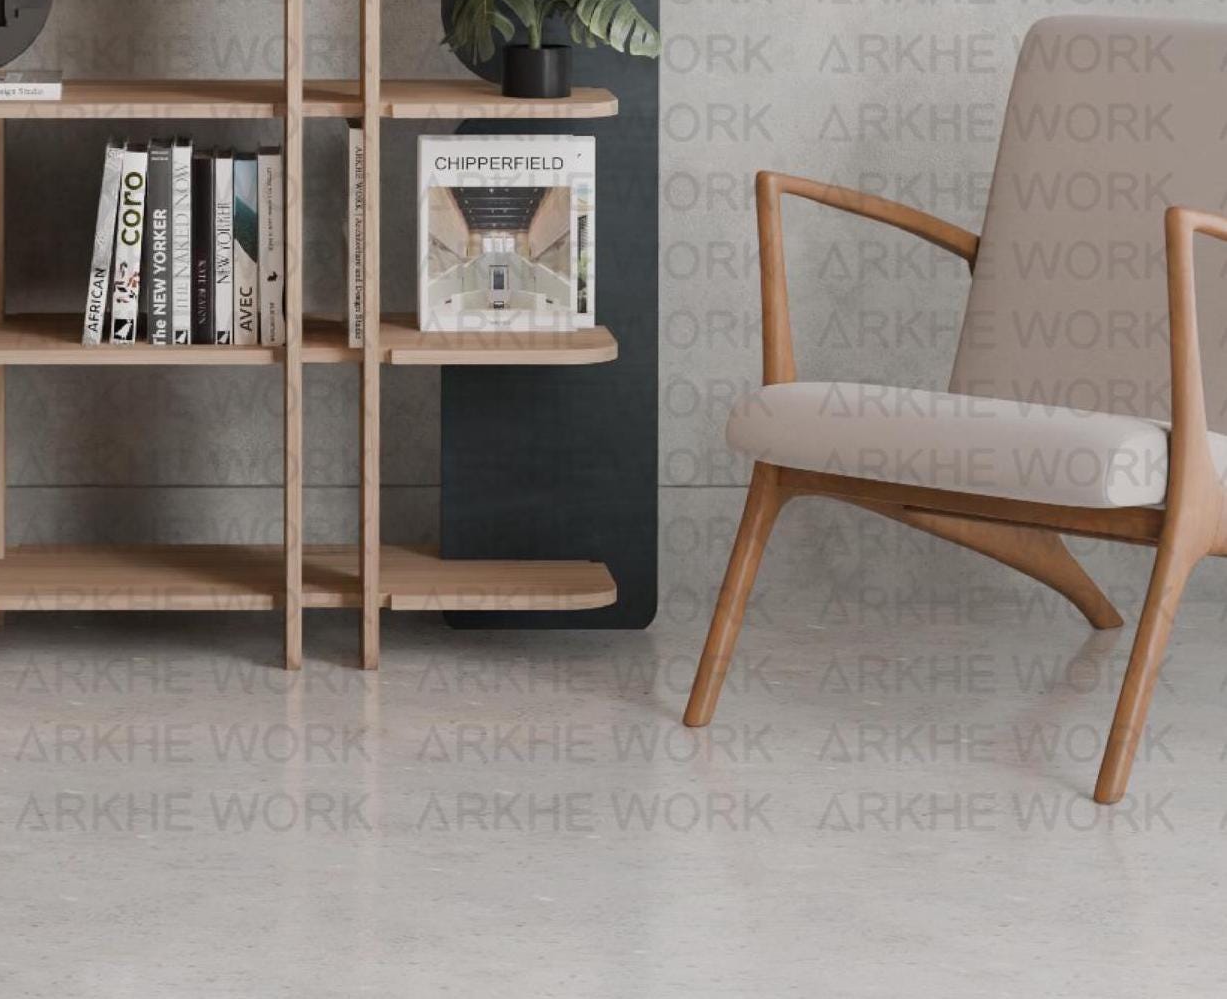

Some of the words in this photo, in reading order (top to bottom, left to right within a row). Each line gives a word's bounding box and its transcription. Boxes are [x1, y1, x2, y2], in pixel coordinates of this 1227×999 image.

[434, 155, 564, 171] CHIPPERFIELD
[175, 160, 189, 209] NOW
[153, 208, 168, 277] YORKER
[216, 255, 231, 284] NEW
[87, 267, 107, 332] AFRICAN
[153, 280, 168, 316] NEW
[239, 285, 253, 332] AVEC
[151, 318, 167, 345] The
